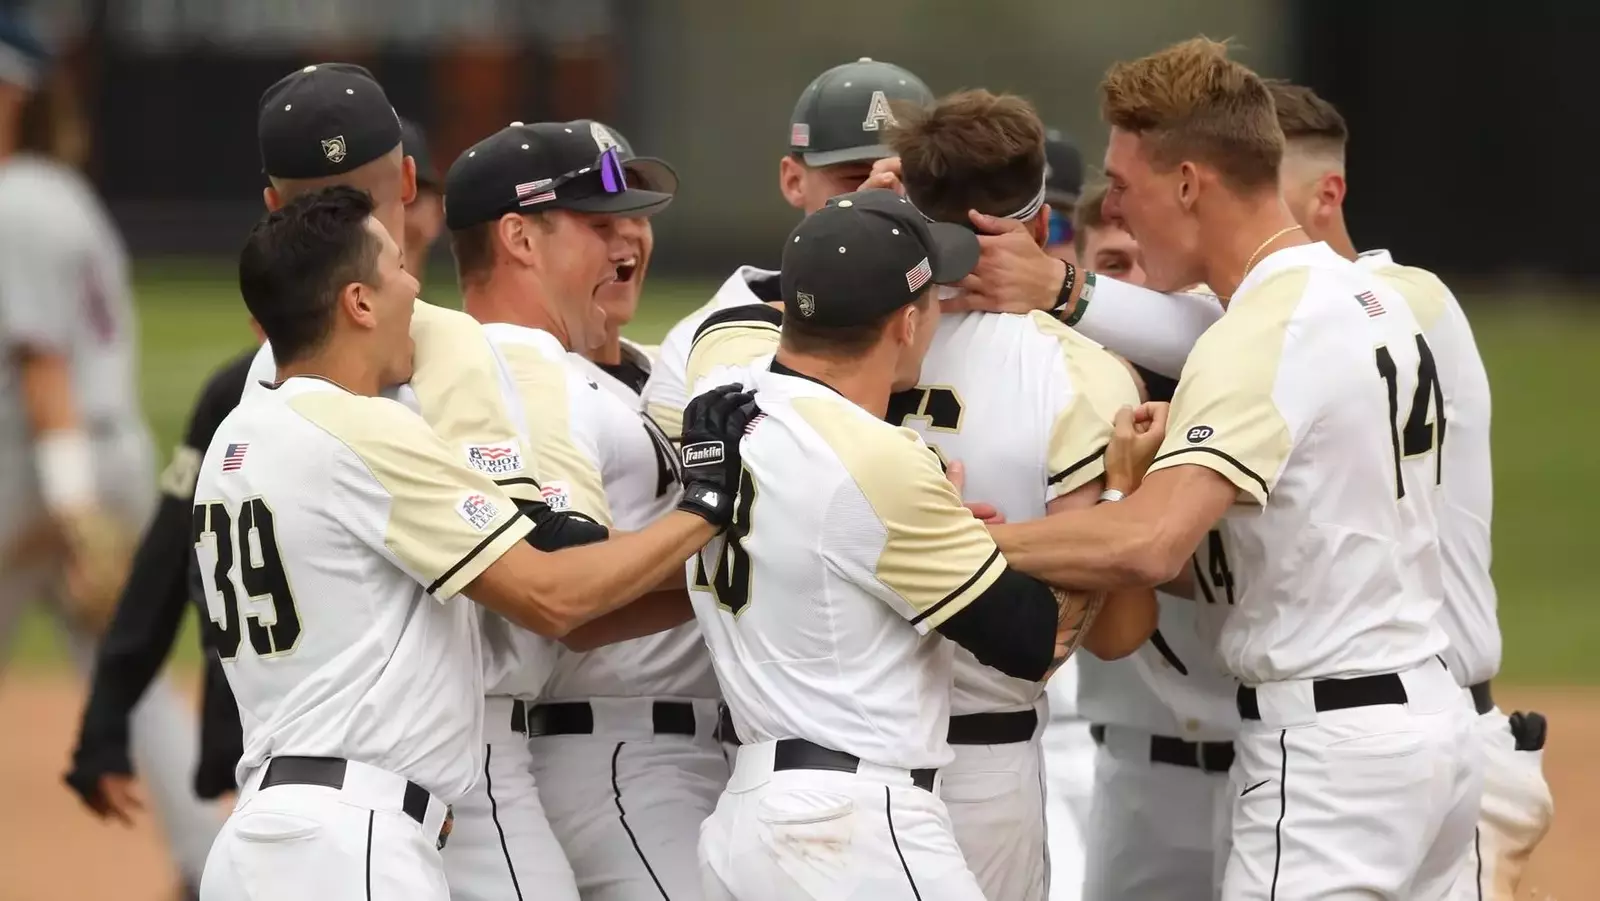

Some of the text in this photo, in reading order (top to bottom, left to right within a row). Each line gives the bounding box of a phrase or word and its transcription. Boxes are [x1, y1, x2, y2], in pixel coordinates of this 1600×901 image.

[863, 90, 900, 131] A
[1189, 429, 1210, 439] 20
[1374, 331, 1448, 501] 14
[193, 496, 303, 661] 39
[692, 463, 759, 621] 8
